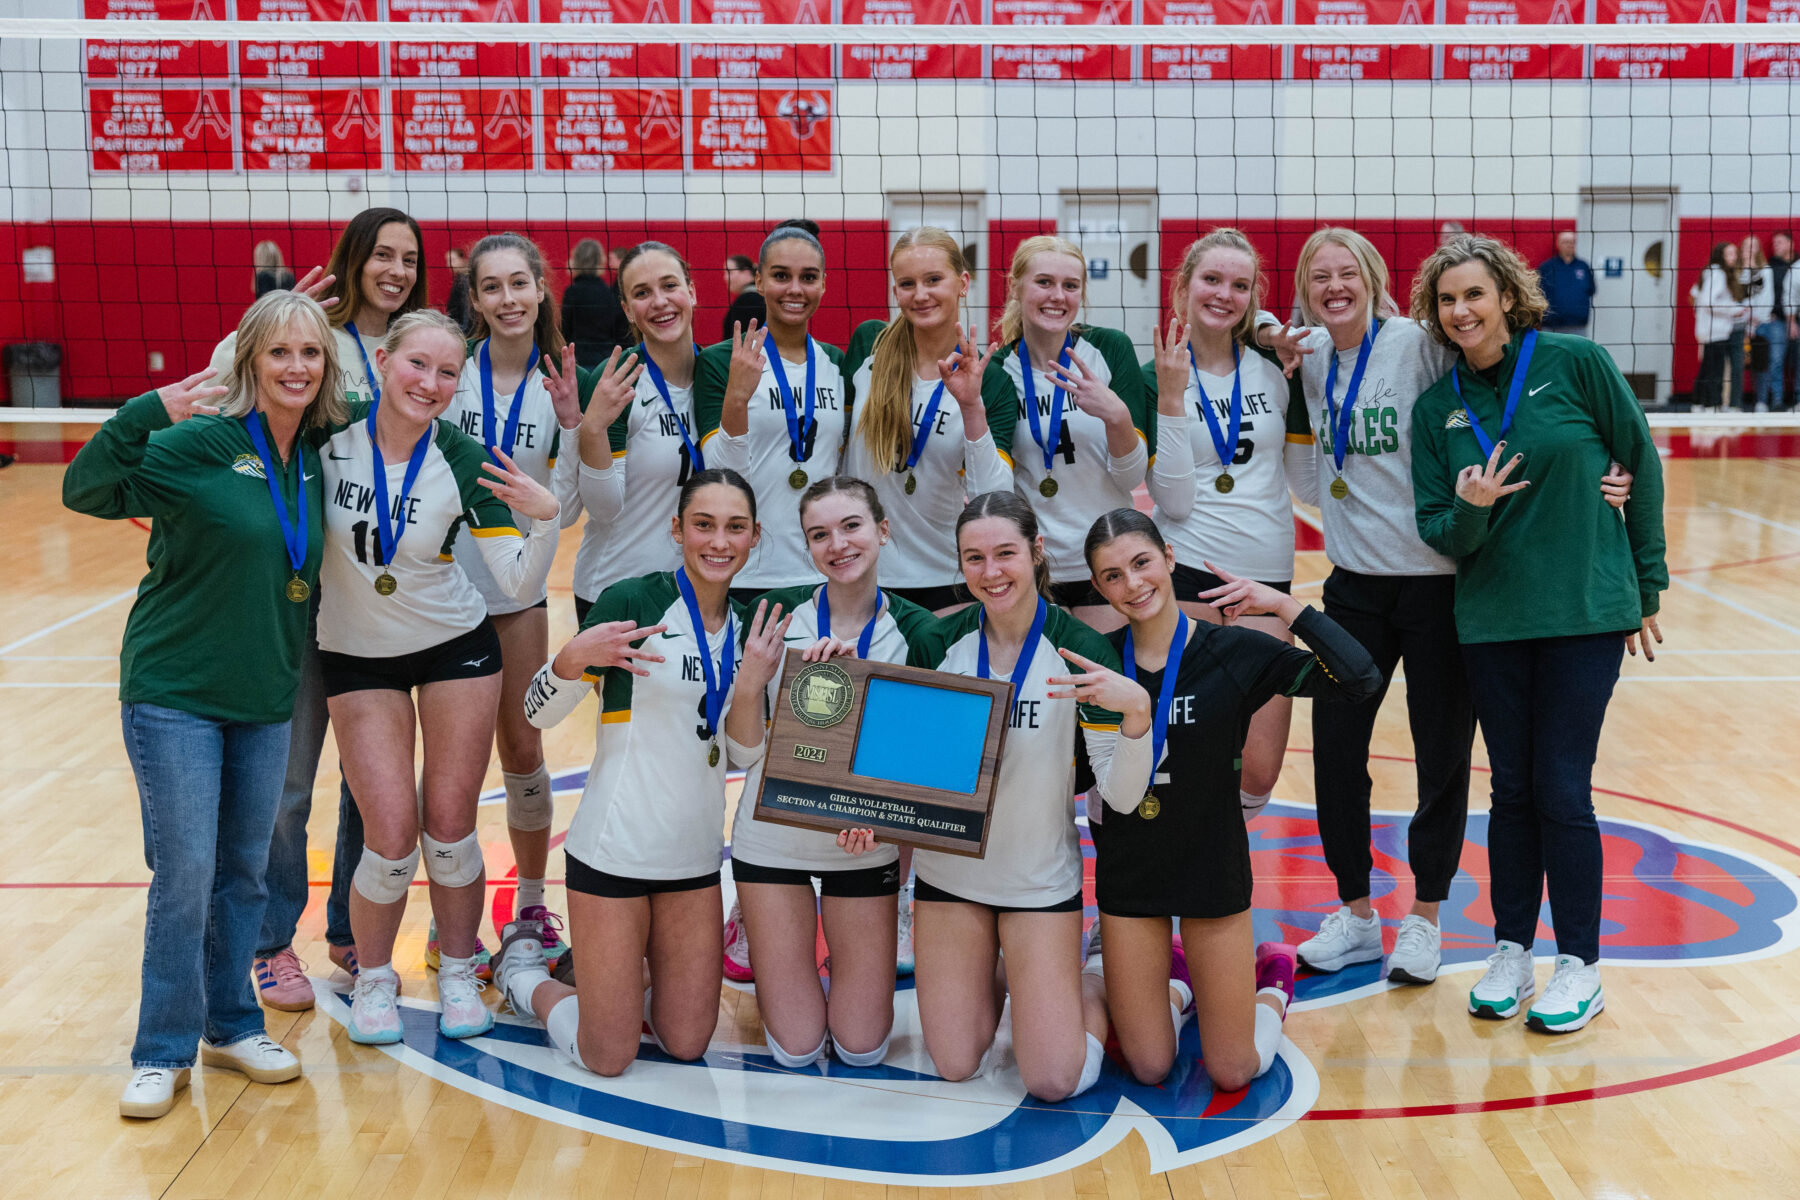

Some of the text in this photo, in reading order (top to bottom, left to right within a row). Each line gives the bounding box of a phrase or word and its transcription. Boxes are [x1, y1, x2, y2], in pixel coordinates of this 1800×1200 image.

[88, 44, 181, 60] PARTICIPANT
[431, 44, 477, 60] PLACE
[116, 62, 157, 78] 1977
[111, 105, 164, 121] STATE
[261, 105, 314, 121] STATE
[412, 105, 466, 121] STATE
[563, 104, 617, 121] STATE
[709, 104, 758, 120] STATE
[151, 121, 174, 135] AA
[301, 120, 323, 135] AA
[453, 120, 475, 135] AA
[603, 120, 625, 135] AA
[744, 119, 767, 135] AA
[93, 137, 184, 151] PARTICIPANT
[769, 387, 802, 410] NW
[1017, 394, 1050, 421] NW
[1054, 418, 1076, 465] 4
[1226, 421, 1254, 465] 5
[333, 478, 422, 525] NEW IFE
[351, 520, 385, 567] 11
[1009, 700, 1041, 729] IFE
[1168, 695, 1196, 725] IFE
[796, 746, 823, 760] 2024
[829, 793, 916, 815] GIRLS VOLLEYBALL
[776, 794, 967, 833] SECTION 4A CHAMPION & STATE QUALIFIER
